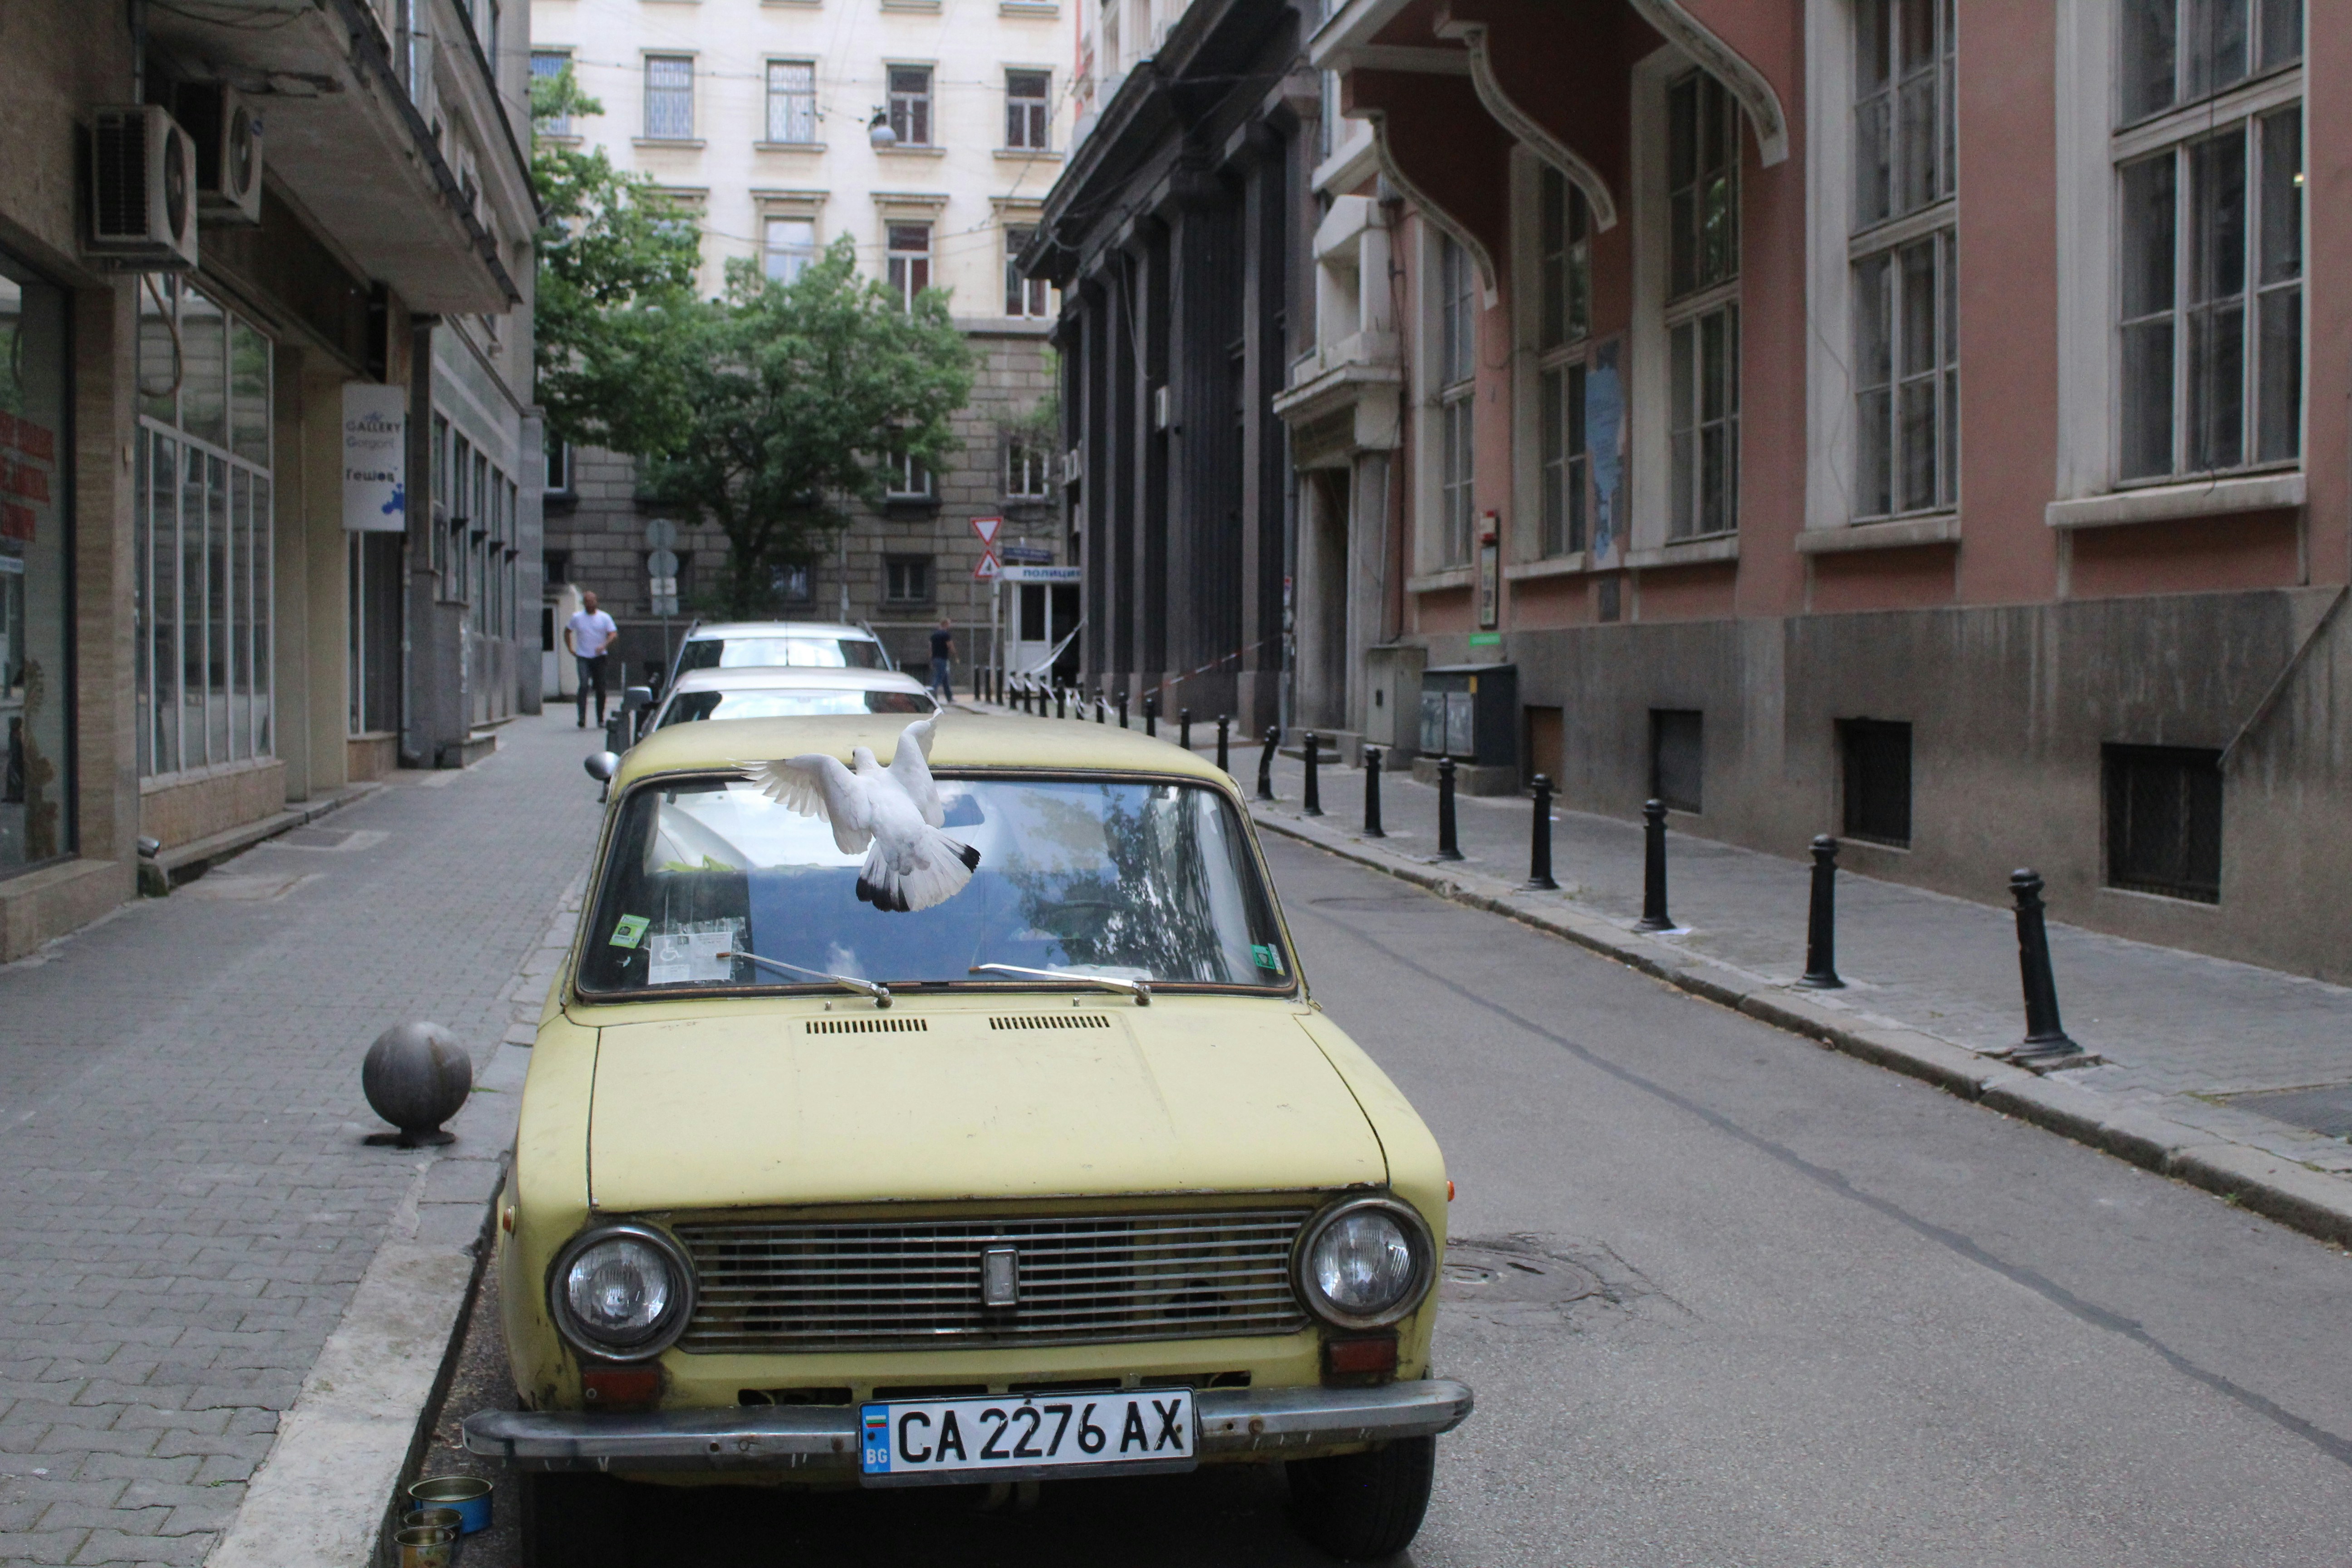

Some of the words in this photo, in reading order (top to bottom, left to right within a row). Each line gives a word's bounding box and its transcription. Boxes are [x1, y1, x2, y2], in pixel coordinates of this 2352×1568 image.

[346, 420, 401, 432] GALLERY
[899, 1410, 967, 1463] CA
[980, 1403, 1106, 1459] 2276
[1120, 1399, 1183, 1452] AX
[866, 1448, 888, 1464] BG
